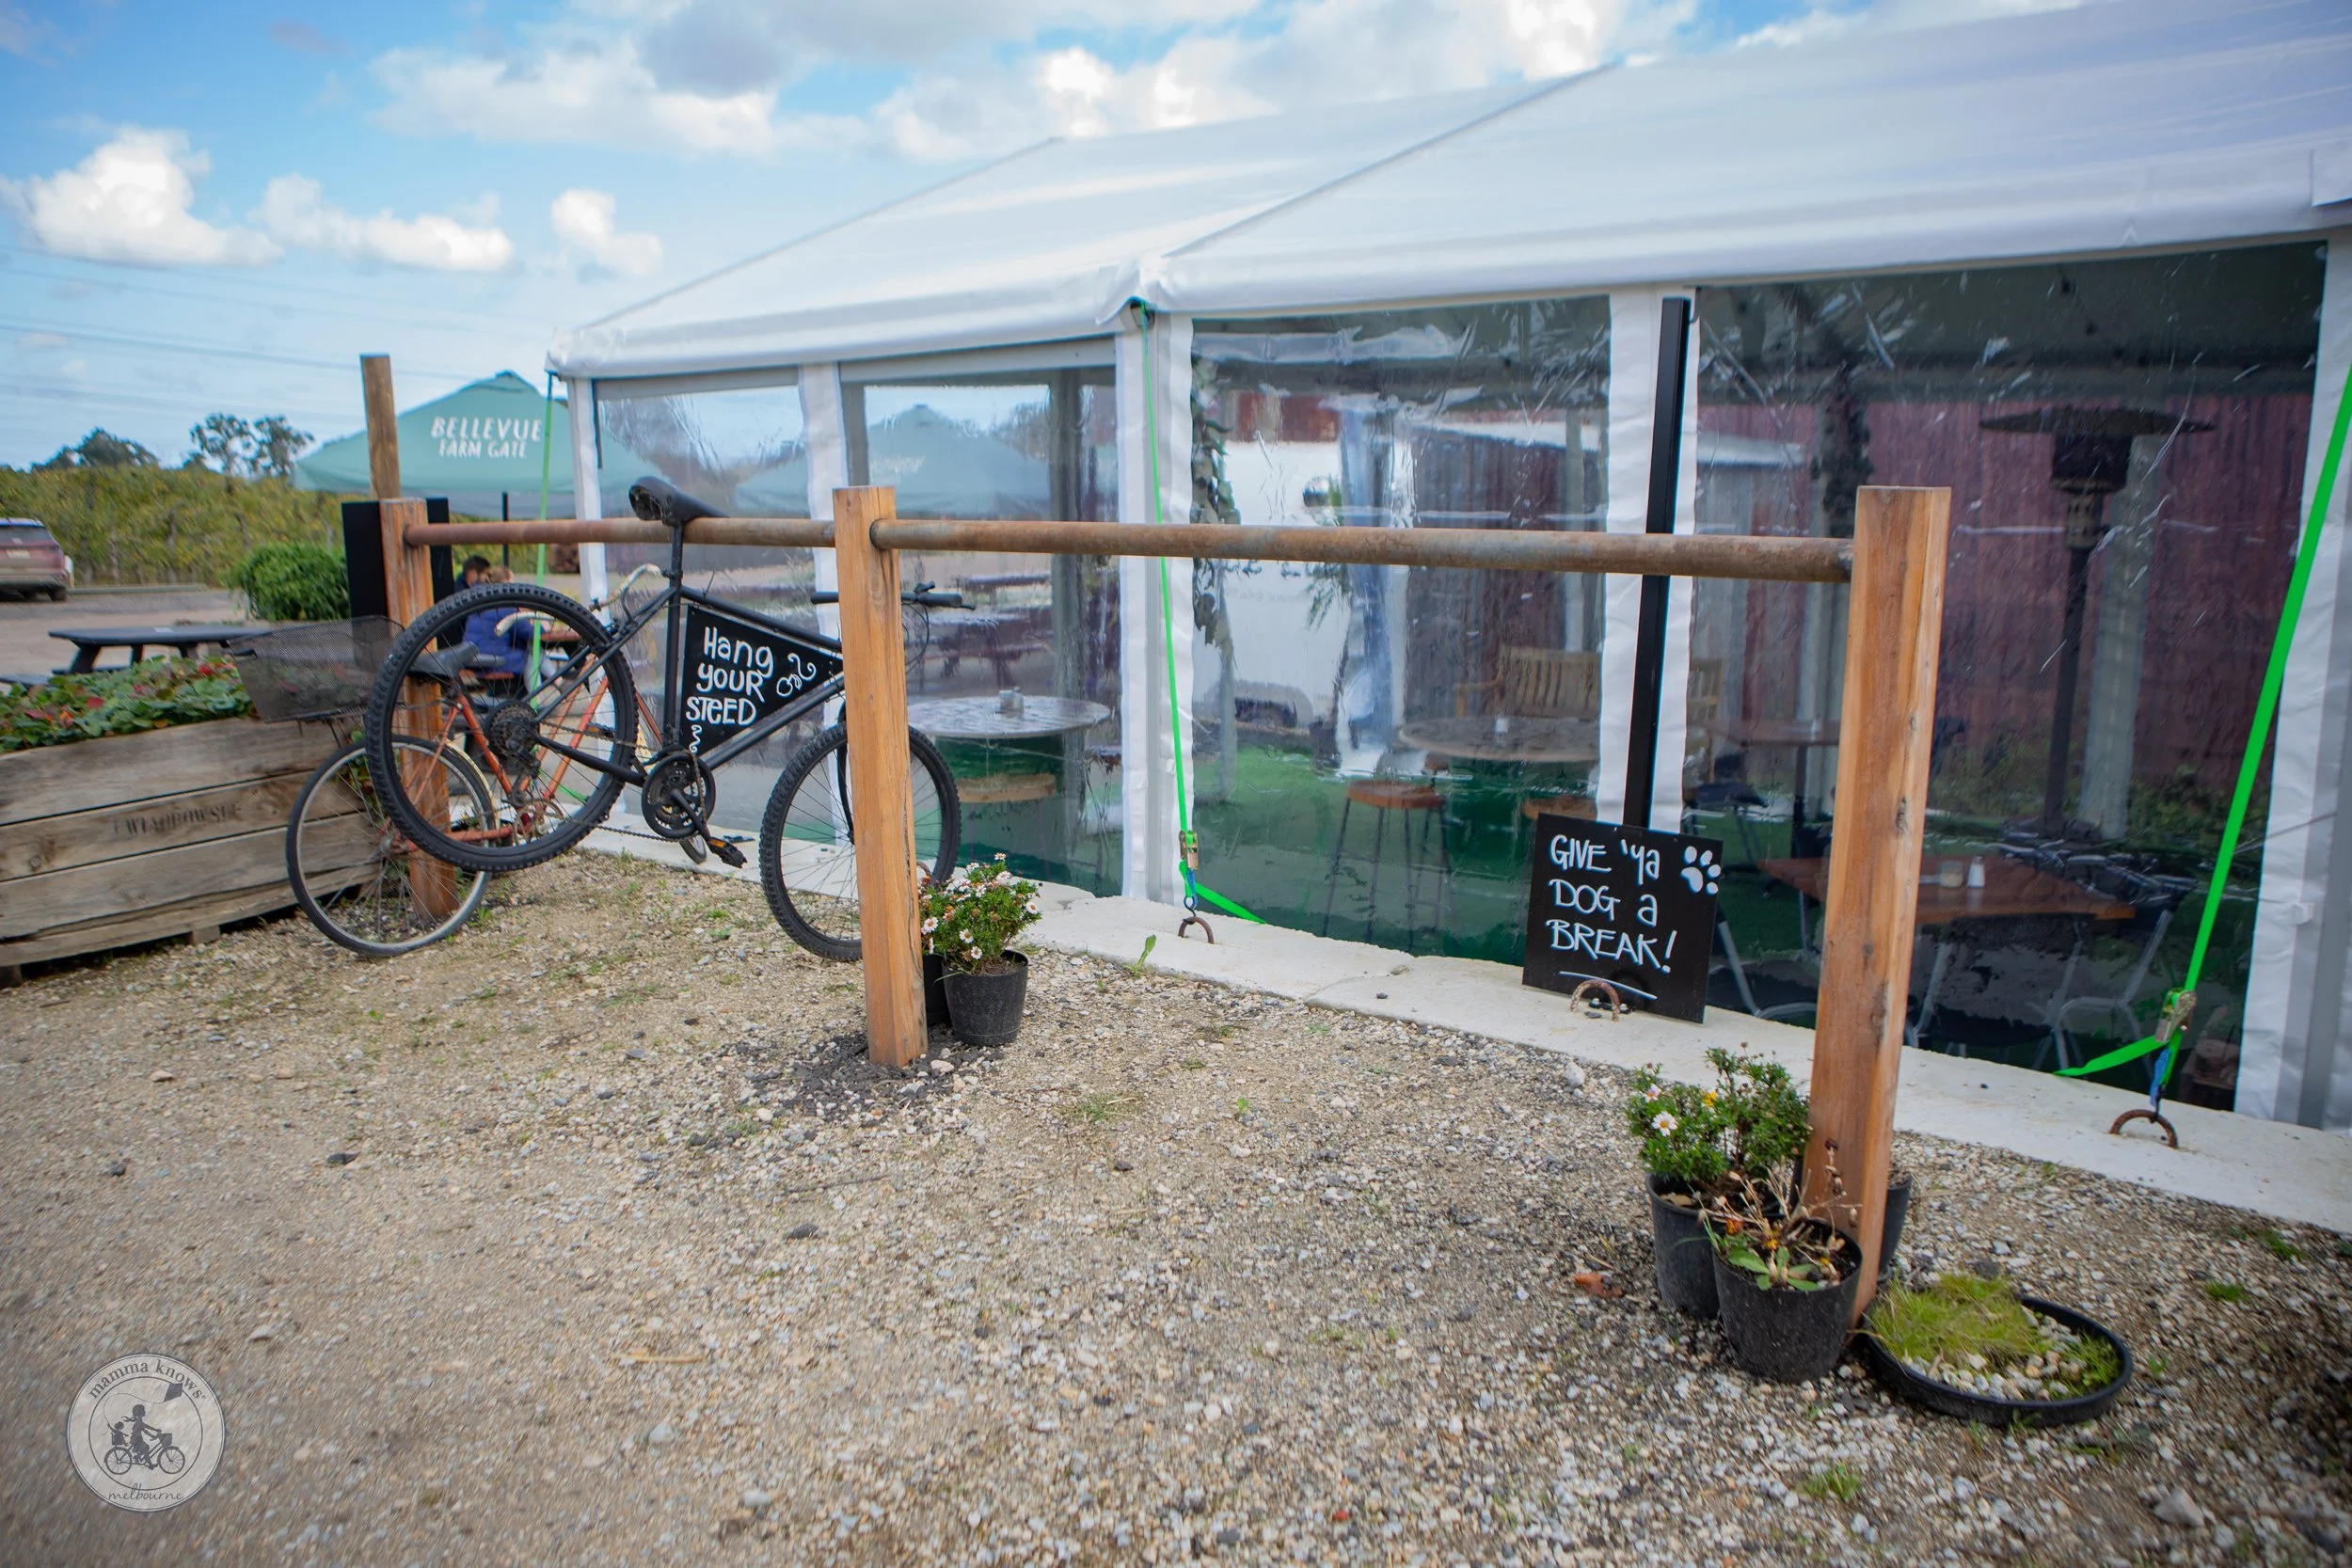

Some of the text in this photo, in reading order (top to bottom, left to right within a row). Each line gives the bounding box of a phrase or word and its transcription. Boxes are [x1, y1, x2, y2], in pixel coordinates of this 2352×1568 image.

[431, 416, 542, 441] BELLEVUE
[703, 626, 774, 678] Hang
[1550, 834, 1612, 872] GIVE
[1548, 879, 1659, 927] DOG a
[1545, 918, 1677, 974] BREAK!
